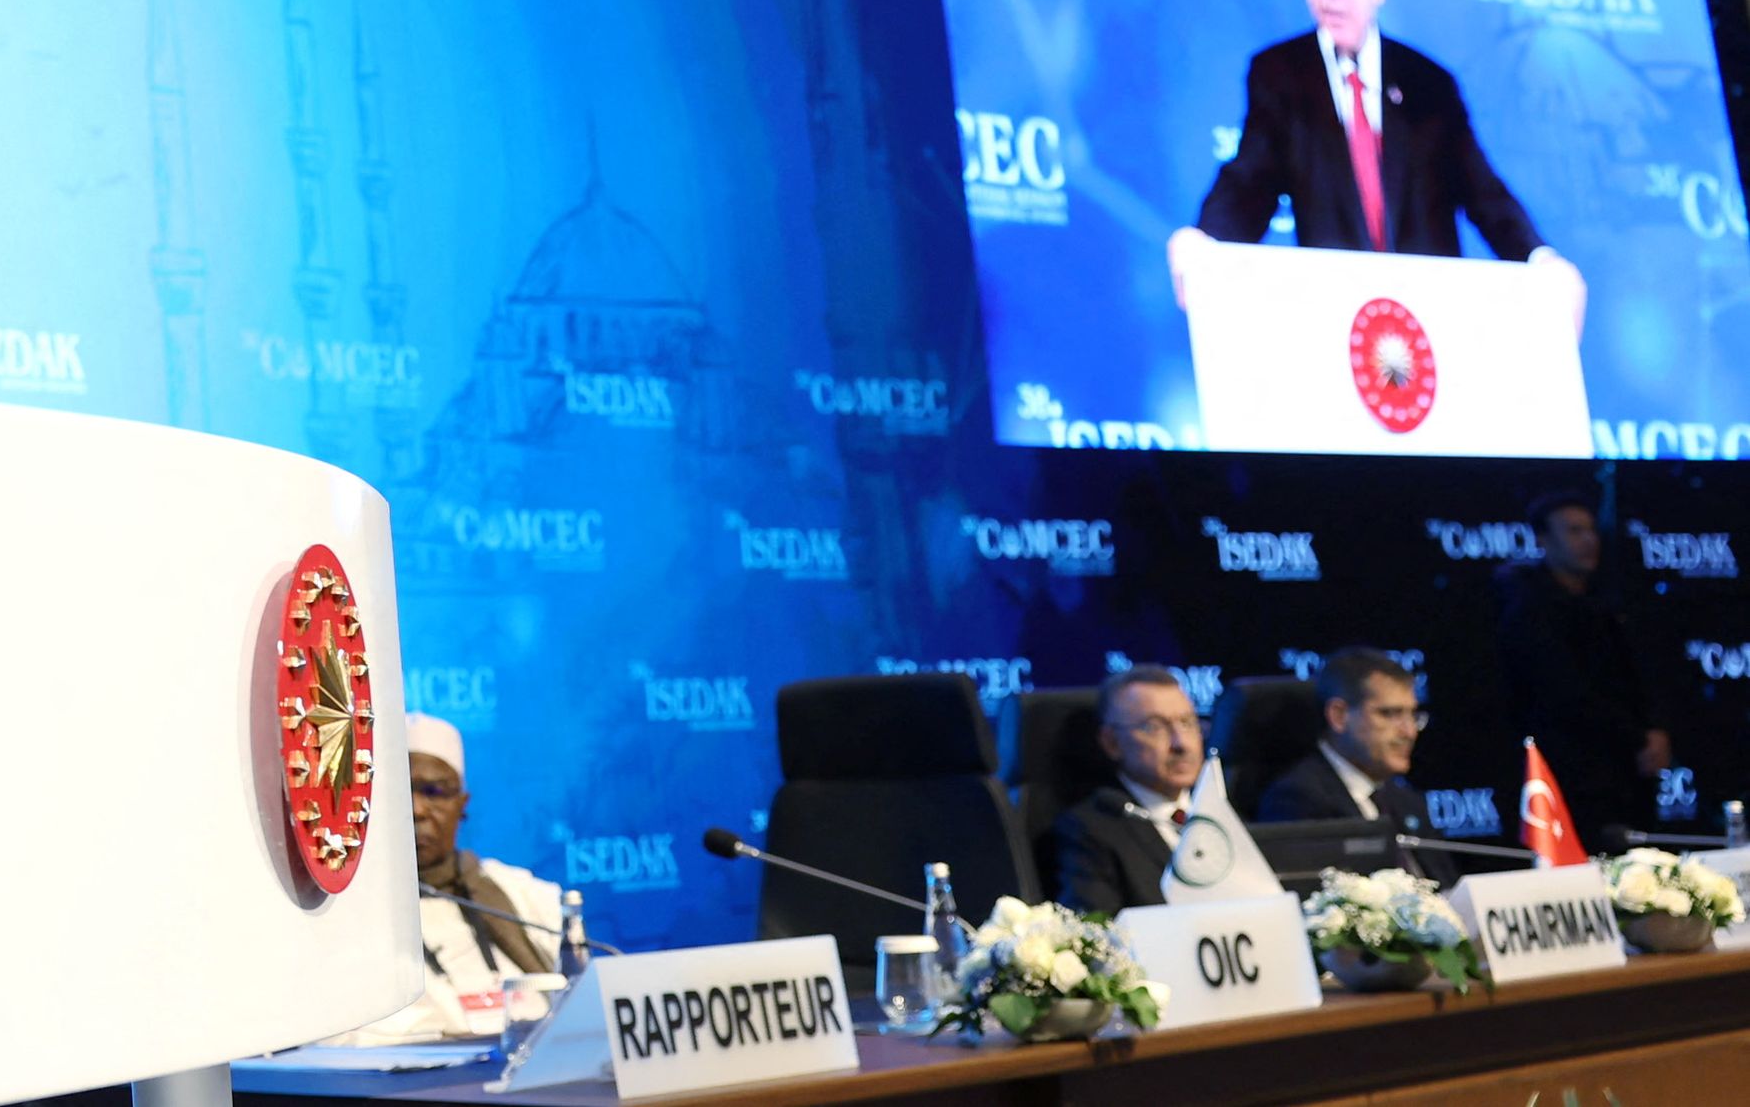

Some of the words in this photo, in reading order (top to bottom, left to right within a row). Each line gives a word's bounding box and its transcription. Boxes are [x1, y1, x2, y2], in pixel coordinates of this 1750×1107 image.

[258, 335, 424, 391] COMCEC
[809, 372, 950, 419] COMCEC
[453, 505, 606, 554] COMCEC
[976, 517, 1115, 561] COMCEC
[1486, 898, 1617, 956] CHAIRMAN
[1197, 932, 1259, 990] OIC
[613, 974, 844, 1061] RAPPORTEUR
